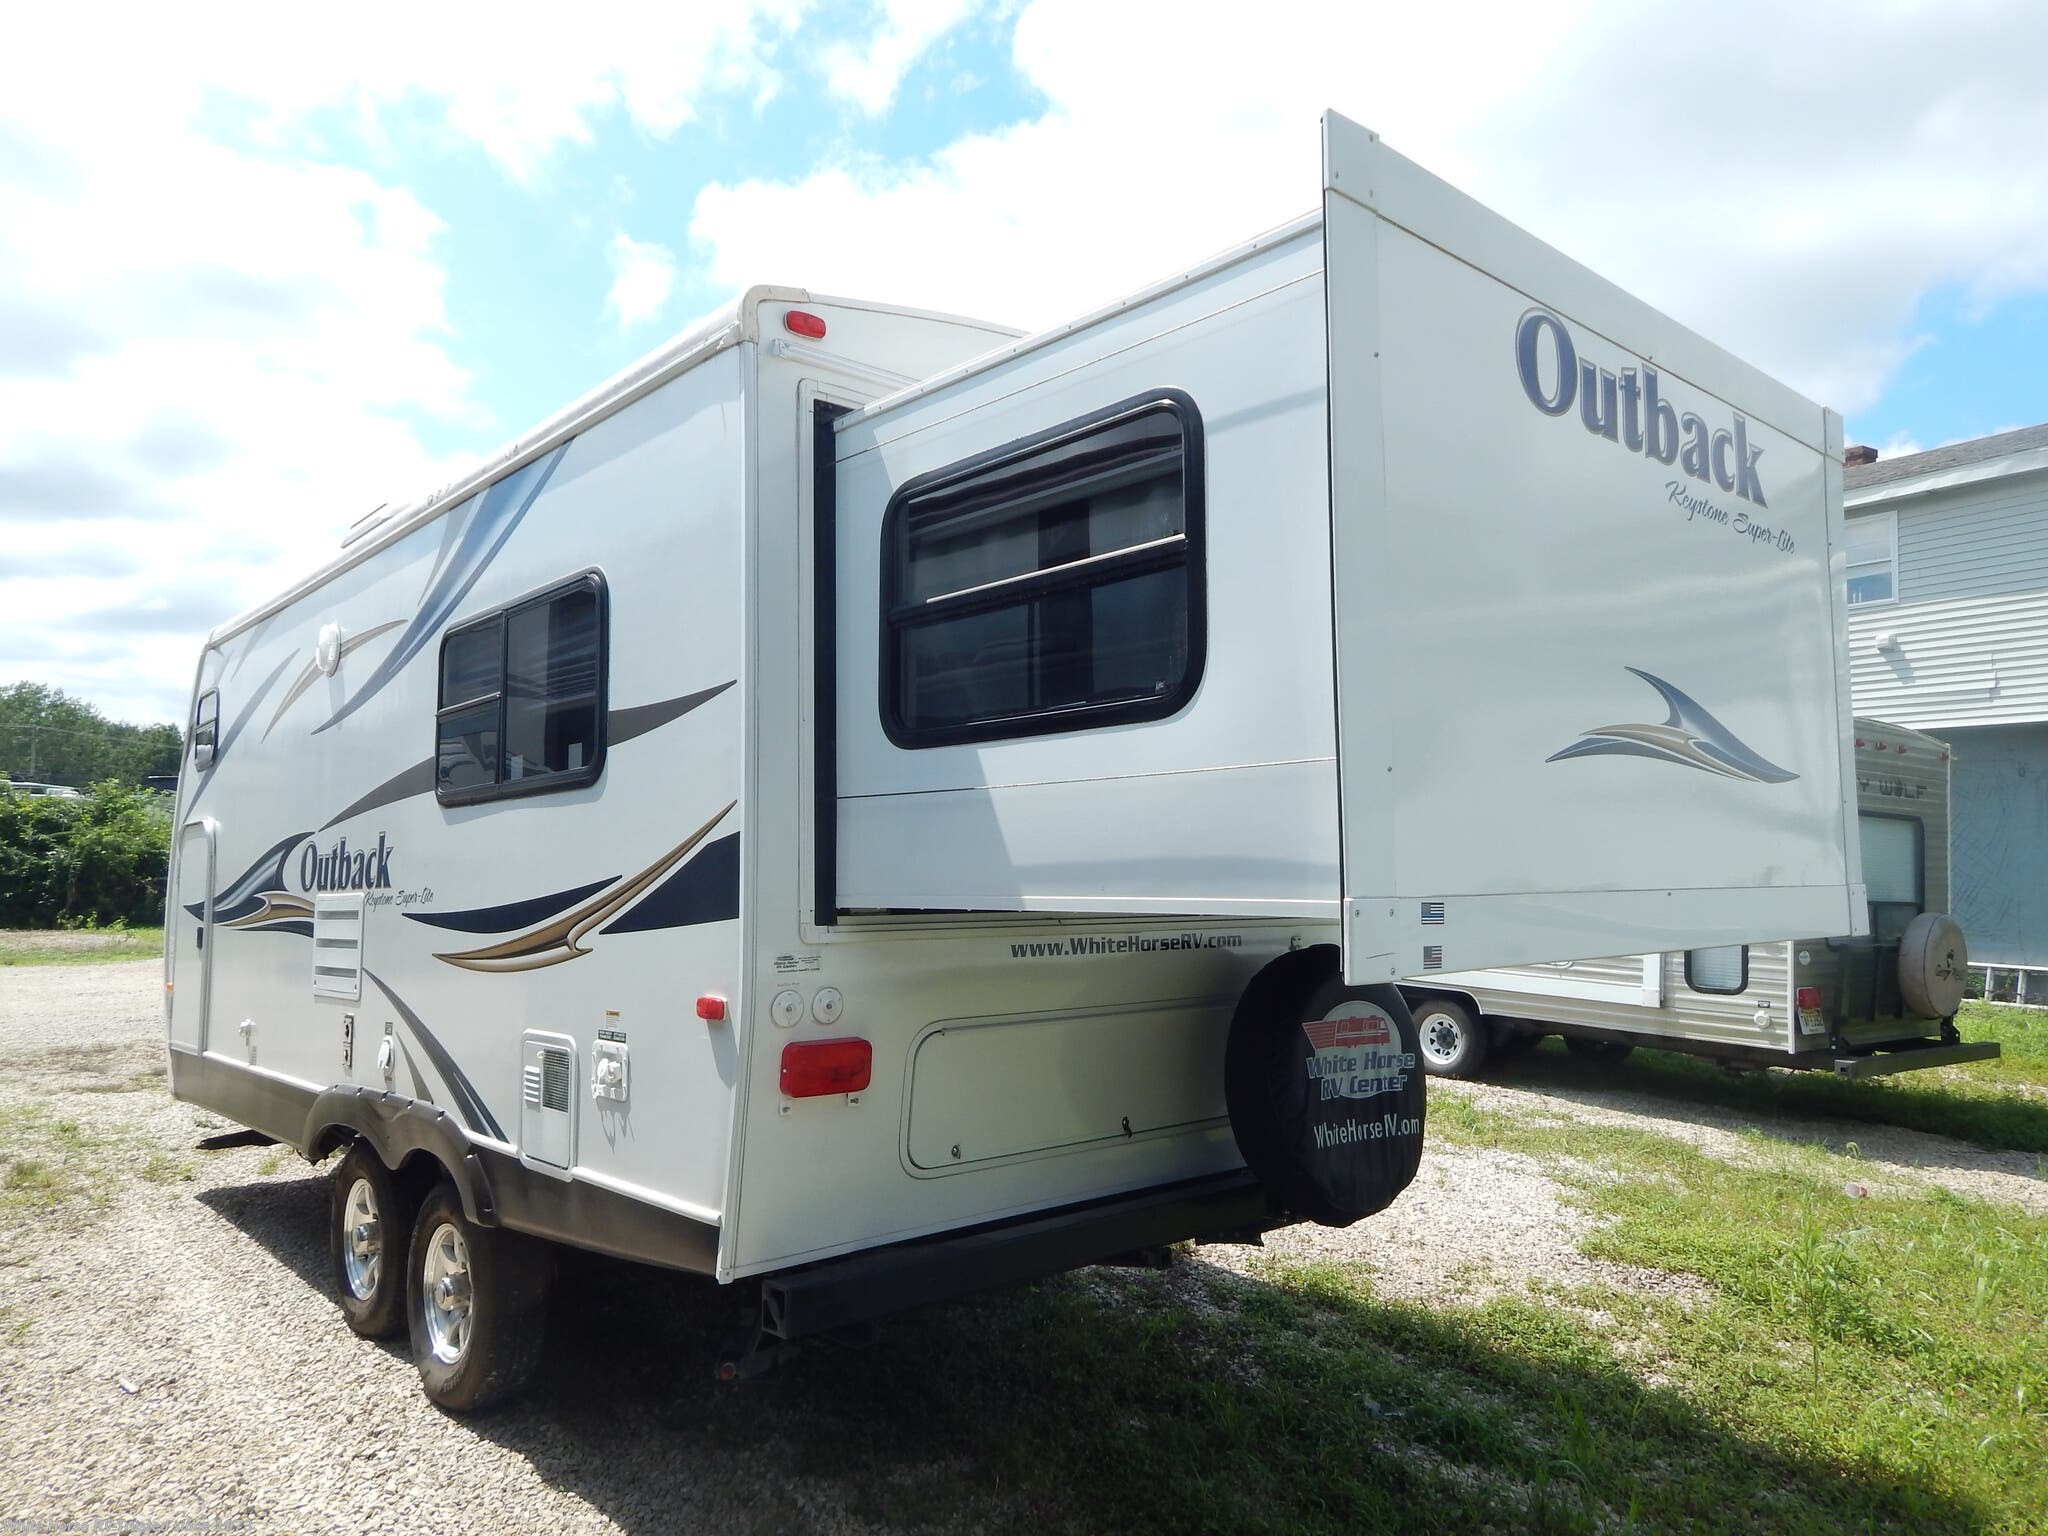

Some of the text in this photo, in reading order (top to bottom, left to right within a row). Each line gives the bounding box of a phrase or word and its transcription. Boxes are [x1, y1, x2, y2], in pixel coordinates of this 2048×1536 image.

[1516, 307, 1768, 509] Outback
[1665, 480, 1795, 554] Keystone Super-Lite
[301, 831, 394, 892] Outback
[1011, 933, 1242, 958] www.WhiteHorseRV.com
[1306, 1051, 1415, 1079] White Horse
[1321, 1074, 1407, 1100] RV Center
